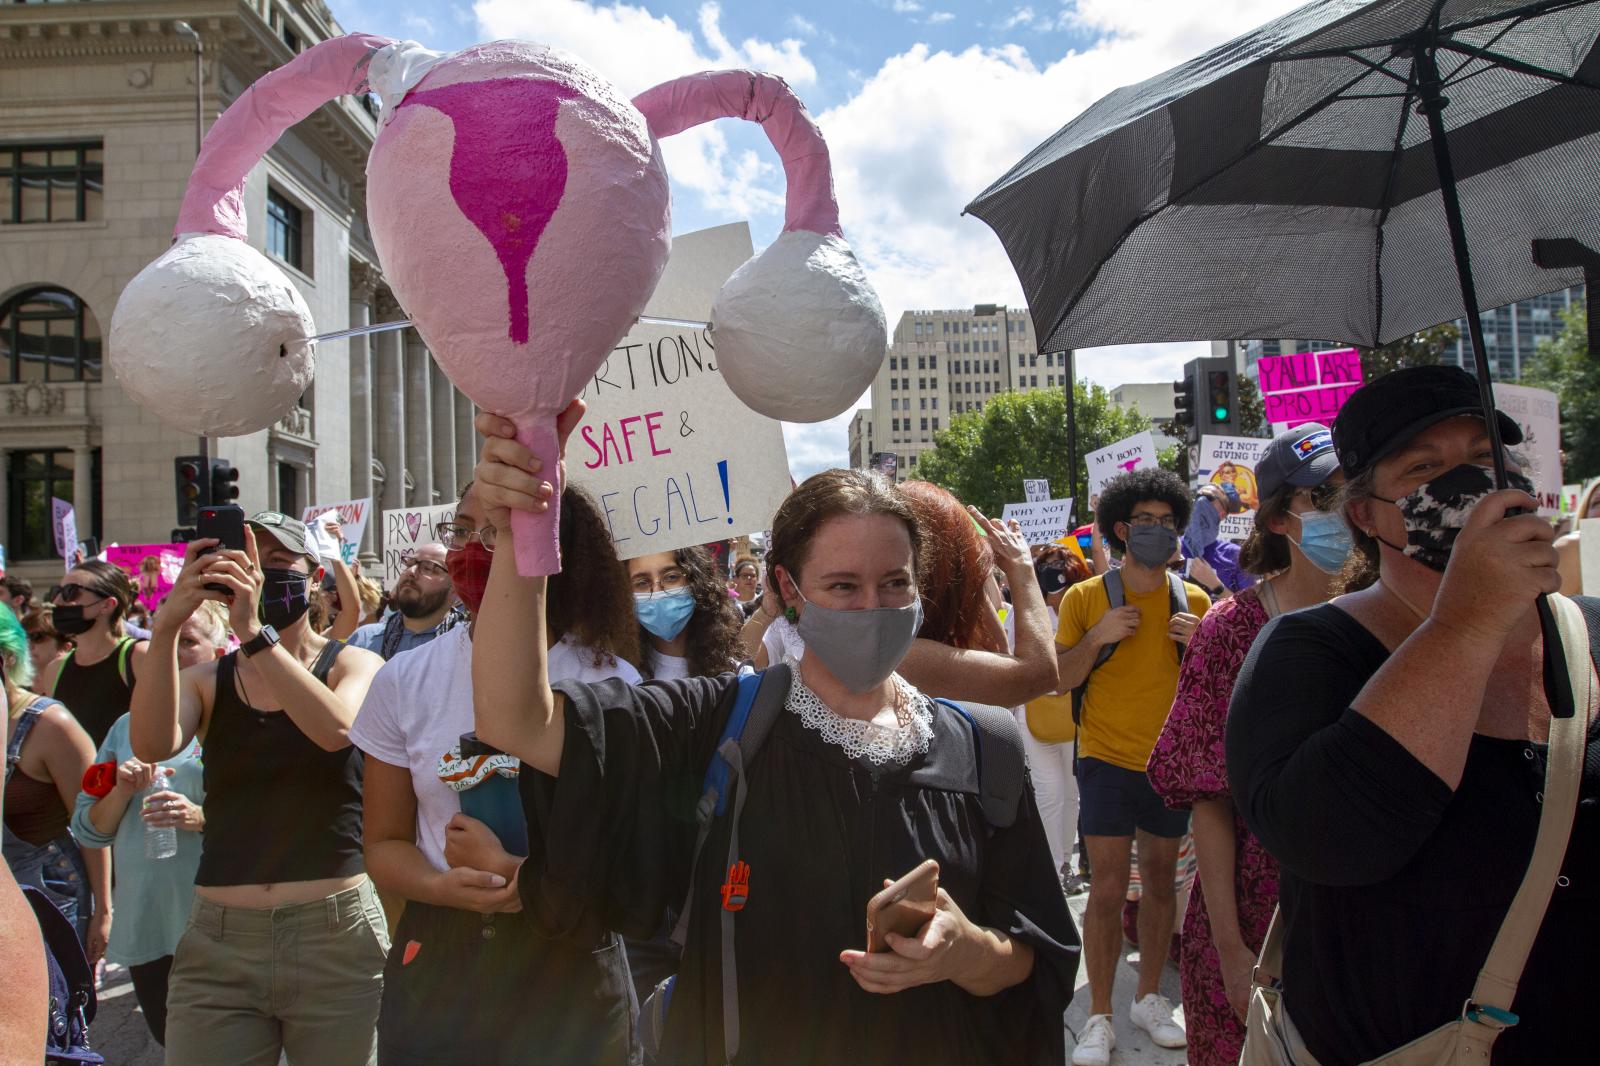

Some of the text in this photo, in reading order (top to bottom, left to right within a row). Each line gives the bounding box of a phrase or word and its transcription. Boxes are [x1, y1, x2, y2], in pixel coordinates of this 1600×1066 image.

[580, 328, 720, 401] RTIONS
[1258, 351, 1359, 393] Y'ALL ARE
[1268, 393, 1312, 419] PRO
[581, 411, 695, 470] SAFE &
[1219, 440, 1259, 451] I'M NOT
[1096, 445, 1143, 465] MY BODY
[1213, 450, 1249, 461] GIVING
[602, 459, 735, 543] EGAL!
[1011, 504, 1065, 517] WHY NOT
[1020, 516, 1061, 527] GULATE
[1220, 525, 1240, 534] ULD
[1030, 529, 1066, 538] BODIES
